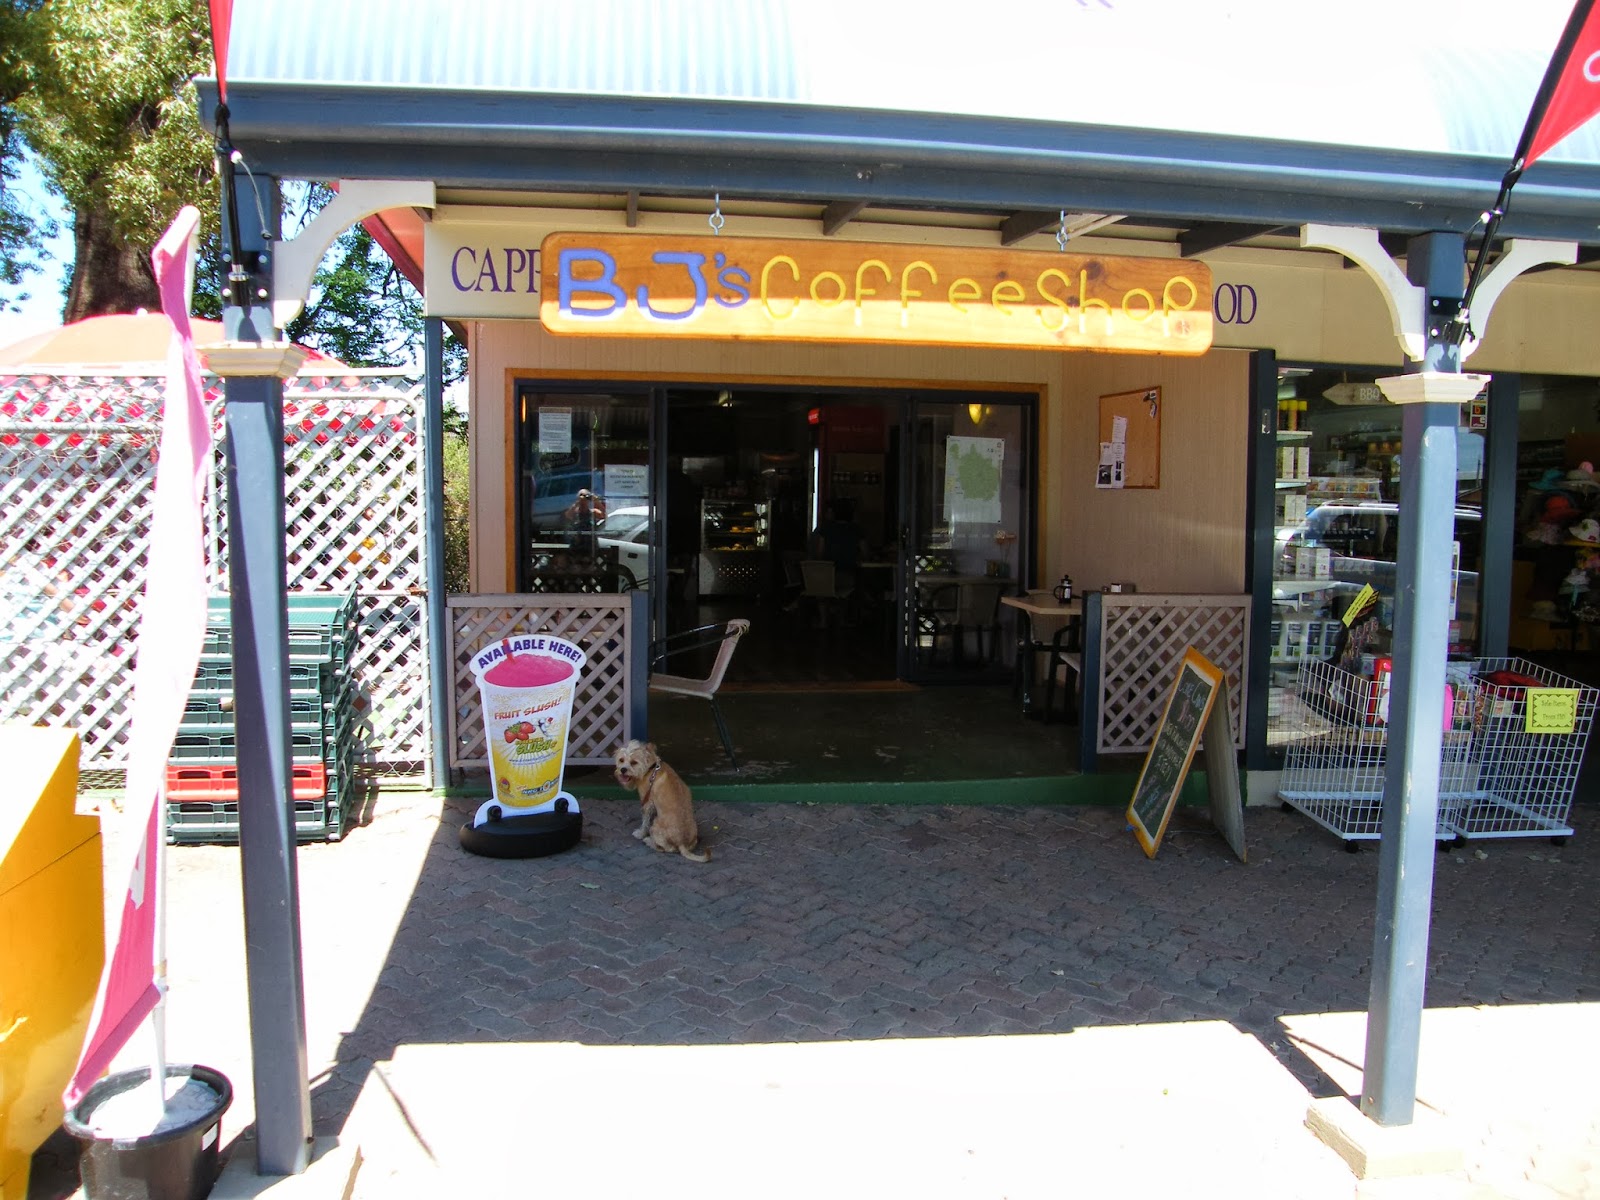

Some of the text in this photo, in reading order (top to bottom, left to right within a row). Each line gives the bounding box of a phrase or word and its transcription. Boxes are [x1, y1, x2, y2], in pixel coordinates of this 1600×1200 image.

[1212, 282, 1258, 325] OD
[1360, 386, 1380, 402] BBQ
[477, 638, 582, 669] AVAILABLE HERE!
[494, 696, 563, 721] FRUIT SLUSH!
